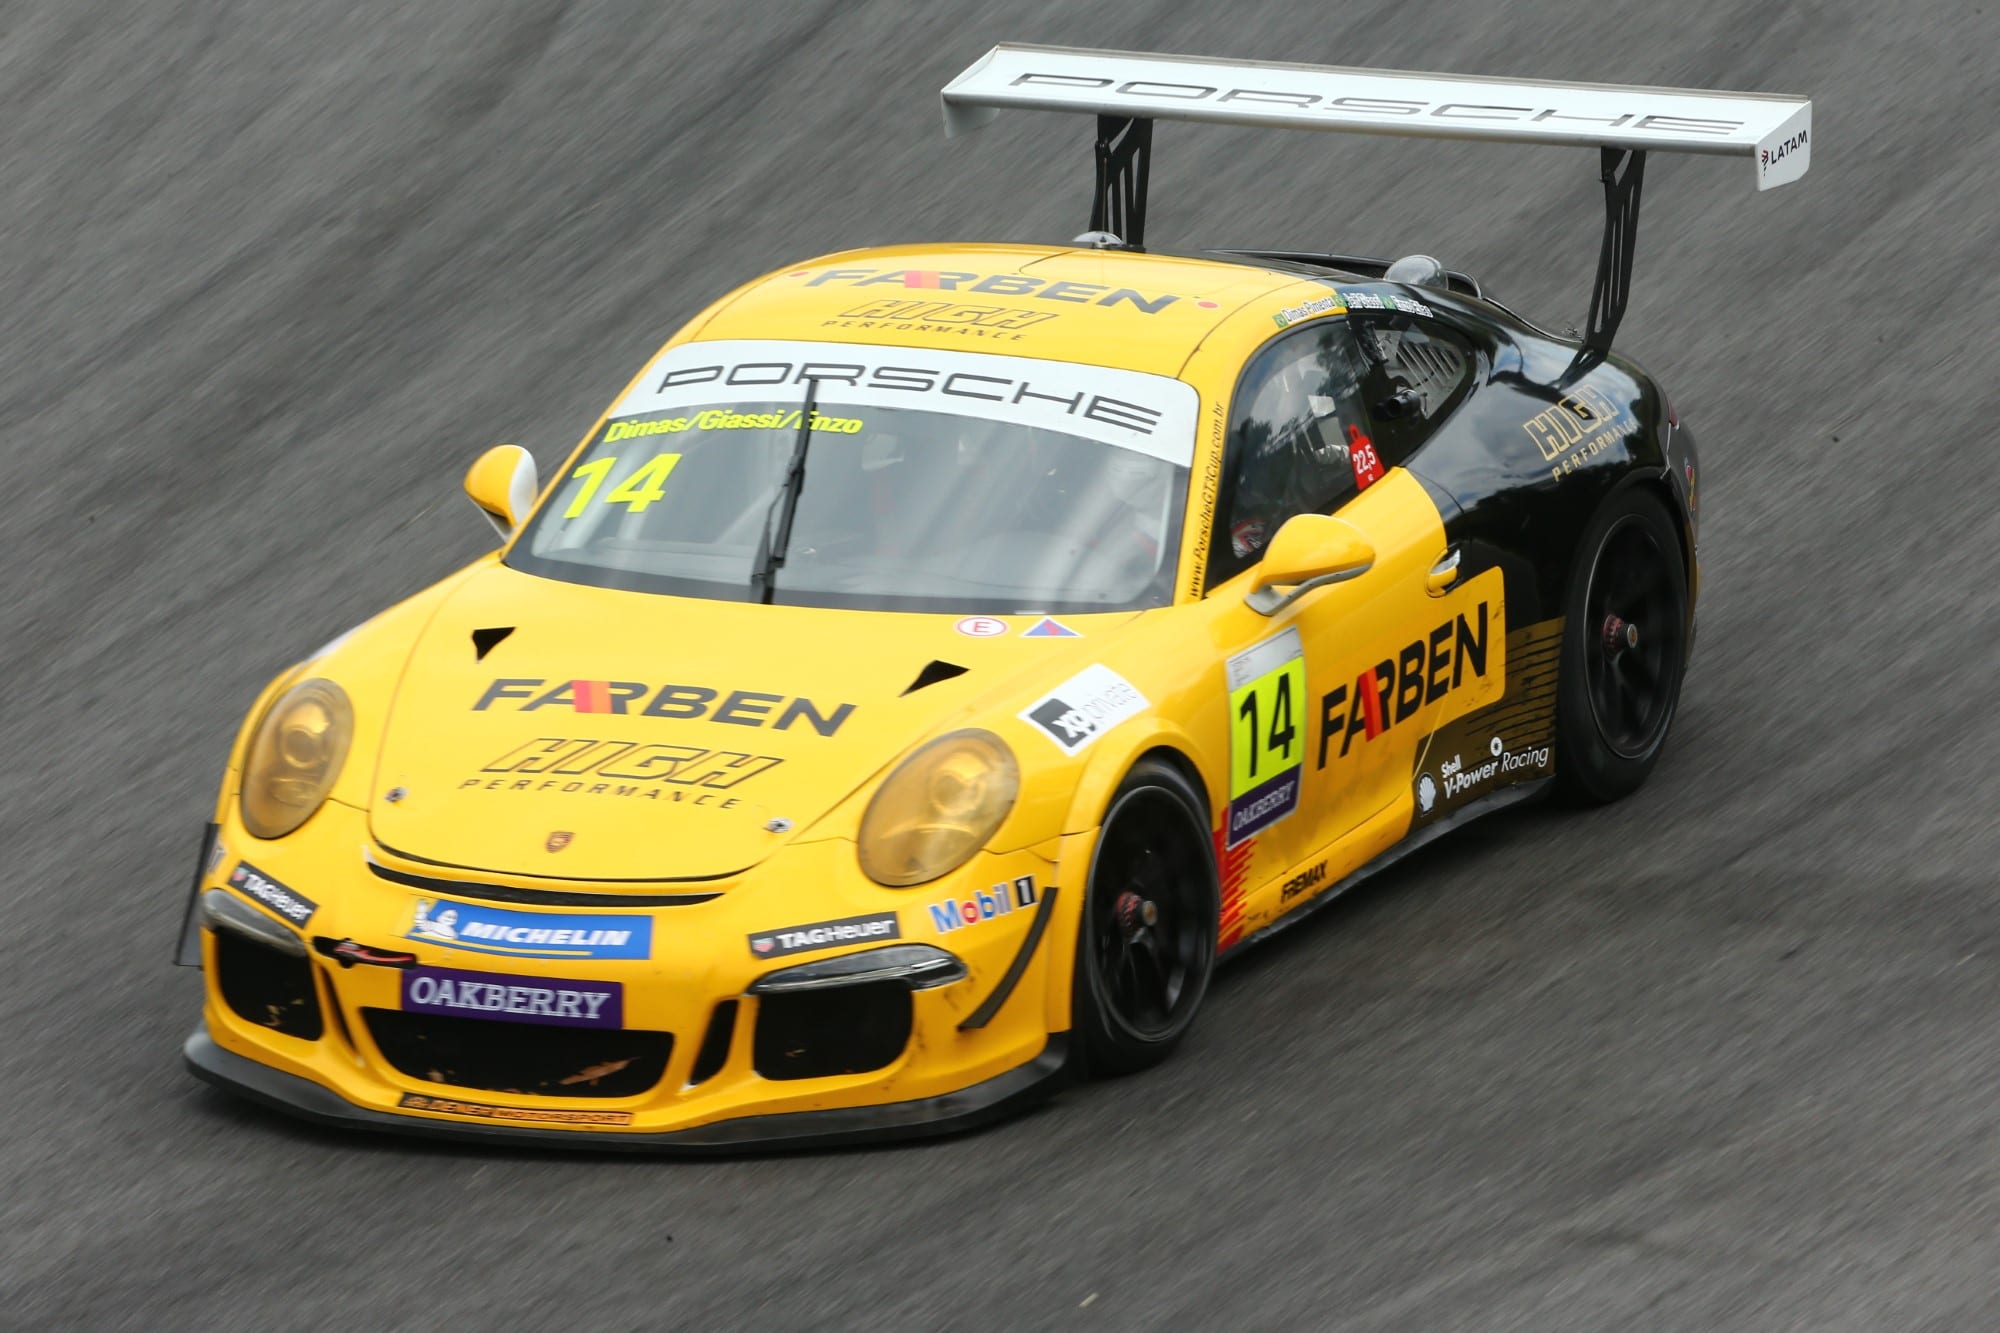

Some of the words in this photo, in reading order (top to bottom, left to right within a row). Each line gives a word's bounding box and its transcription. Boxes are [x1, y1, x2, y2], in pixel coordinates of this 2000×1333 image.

[1009, 73, 1745, 135] PORSCHE
[1771, 131, 1808, 167] LATAM
[804, 268, 1179, 314] FARBEN
[838, 299, 1060, 329] HIGH
[821, 320, 1026, 341] PERFORMANCE
[657, 362, 1163, 435] PORSCHE
[1522, 384, 1620, 461] HIGH
[564, 453, 682, 518] 14
[1190, 400, 1226, 598] www.PorscheGT3Cup.com.br
[470, 679, 857, 737] FARBEN
[1317, 601, 1489, 771] FARBEN
[1240, 672, 1296, 778] 14
[481, 738, 785, 790] HIGH
[1441, 754, 1462, 779] Shell
[1443, 760, 1499, 800] V-Power
[1501, 744, 1550, 771] Racing
[459, 778, 743, 810] PERFORMANCE
[459, 921, 633, 946] MICHELIN
[928, 882, 1012, 934] Mobil
[1017, 877, 1032, 906] 1
[409, 976, 612, 1018] OAKBERRY
